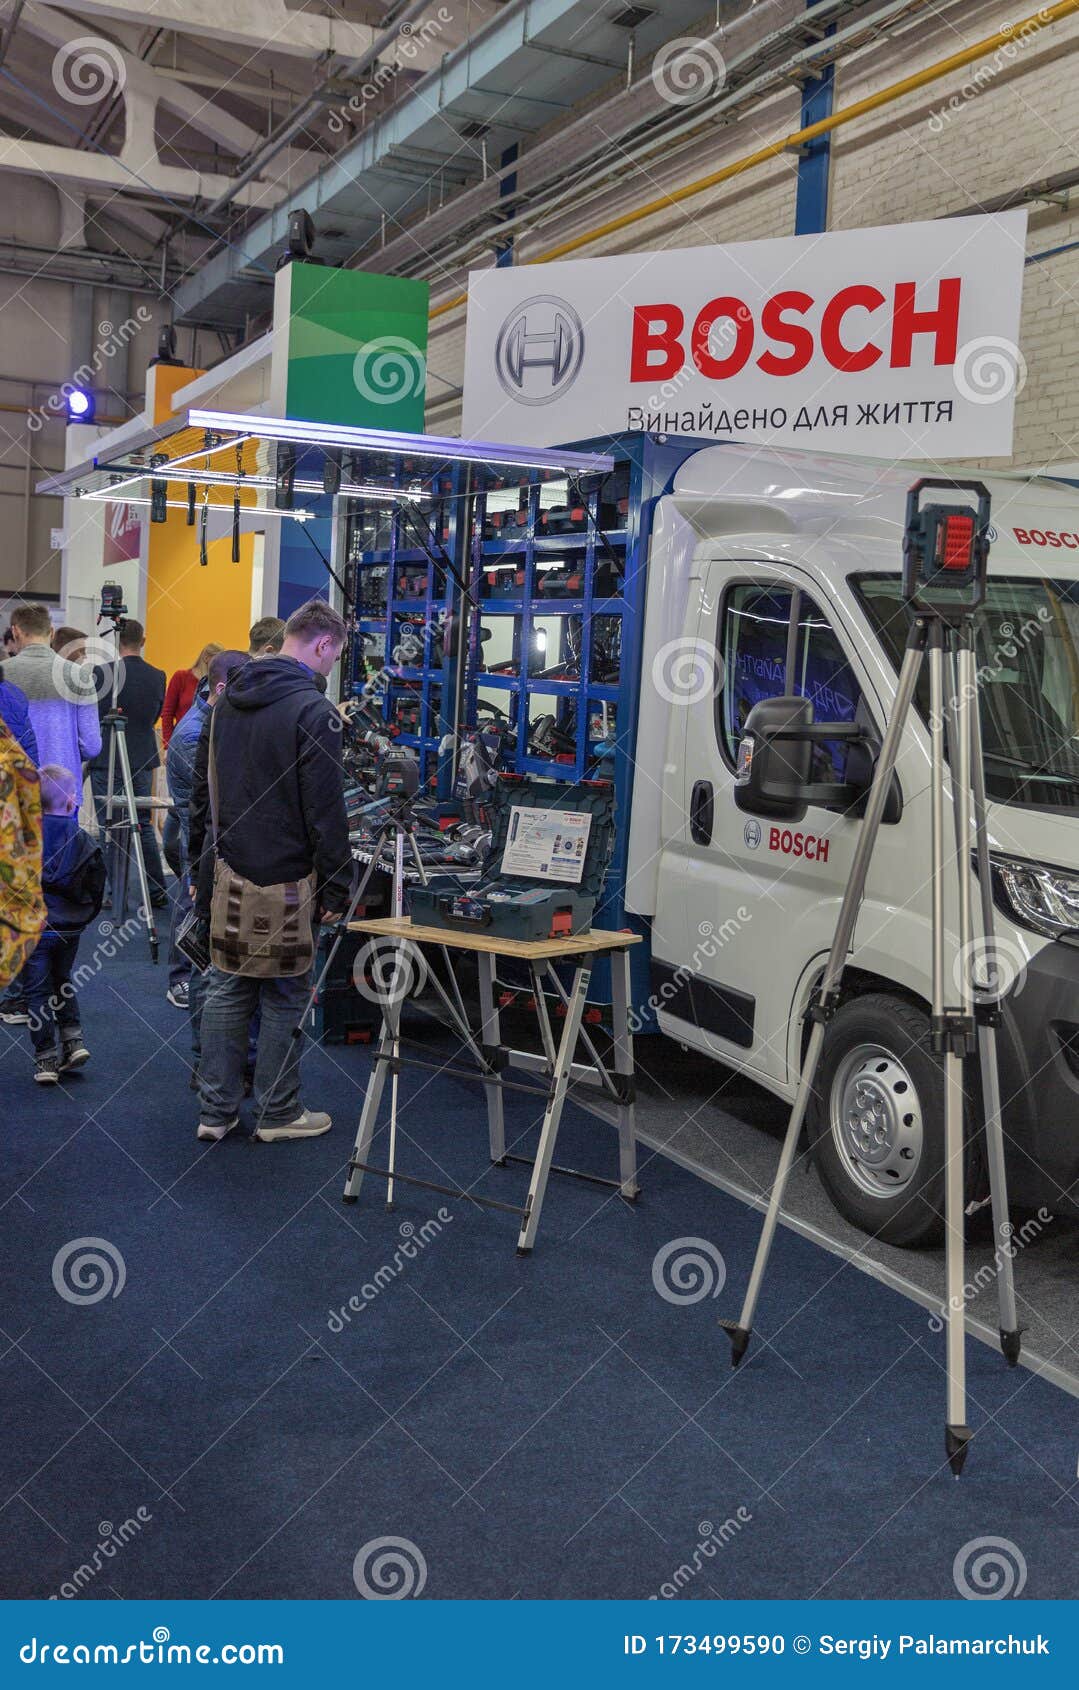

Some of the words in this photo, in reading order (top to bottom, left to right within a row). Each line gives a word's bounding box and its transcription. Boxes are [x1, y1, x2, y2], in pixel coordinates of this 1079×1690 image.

[630, 277, 961, 382] BOSCH
[627, 402, 788, 434] Винайдено
[793, 405, 848, 431] для
[856, 400, 953, 426] життя
[769, 827, 830, 863] BOSCH
